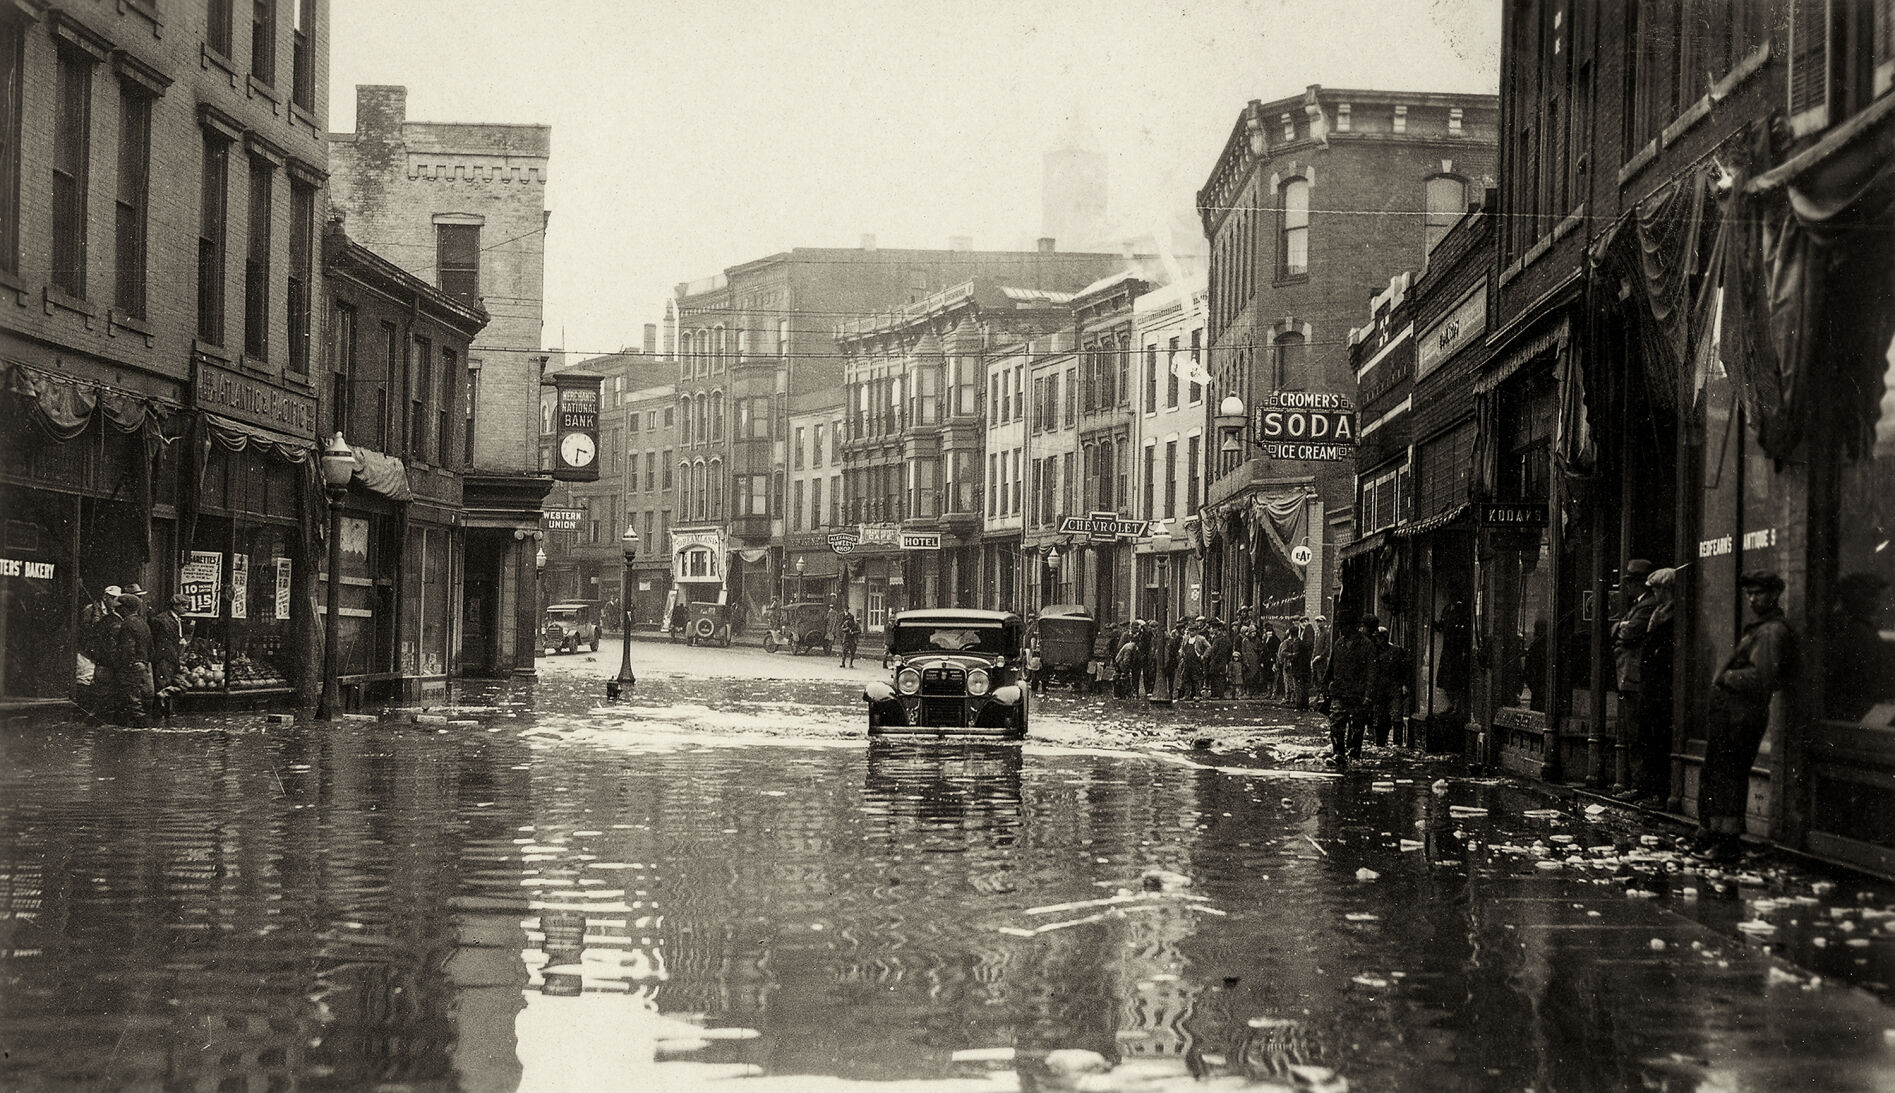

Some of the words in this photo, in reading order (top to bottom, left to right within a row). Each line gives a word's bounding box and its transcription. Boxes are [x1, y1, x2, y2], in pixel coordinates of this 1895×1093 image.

[218, 375, 260, 414] ATLANTIC
[270, 390, 306, 428] PACIFIC
[562, 391, 597, 402] MERCHANTS
[1280, 393, 1339, 408] CROMER'S
[562, 402, 598, 414] NATIONAL
[565, 414, 594, 428] BANK
[1264, 412, 1352, 439] SODA
[1278, 445, 1296, 459] ICE
[1298, 445, 1337, 460] CREAM
[543, 511, 581, 520] WESTERN
[548, 520, 576, 529] UNION
[1068, 520, 1140, 533] CHEVROLET
[830, 534, 857, 542] ALEXANDER
[905, 537, 937, 546] HOTEL
[1743, 529, 1769, 550] ANTIQUE
[25, 561, 55, 579] BAKERY
[185, 584, 198, 594] 10
